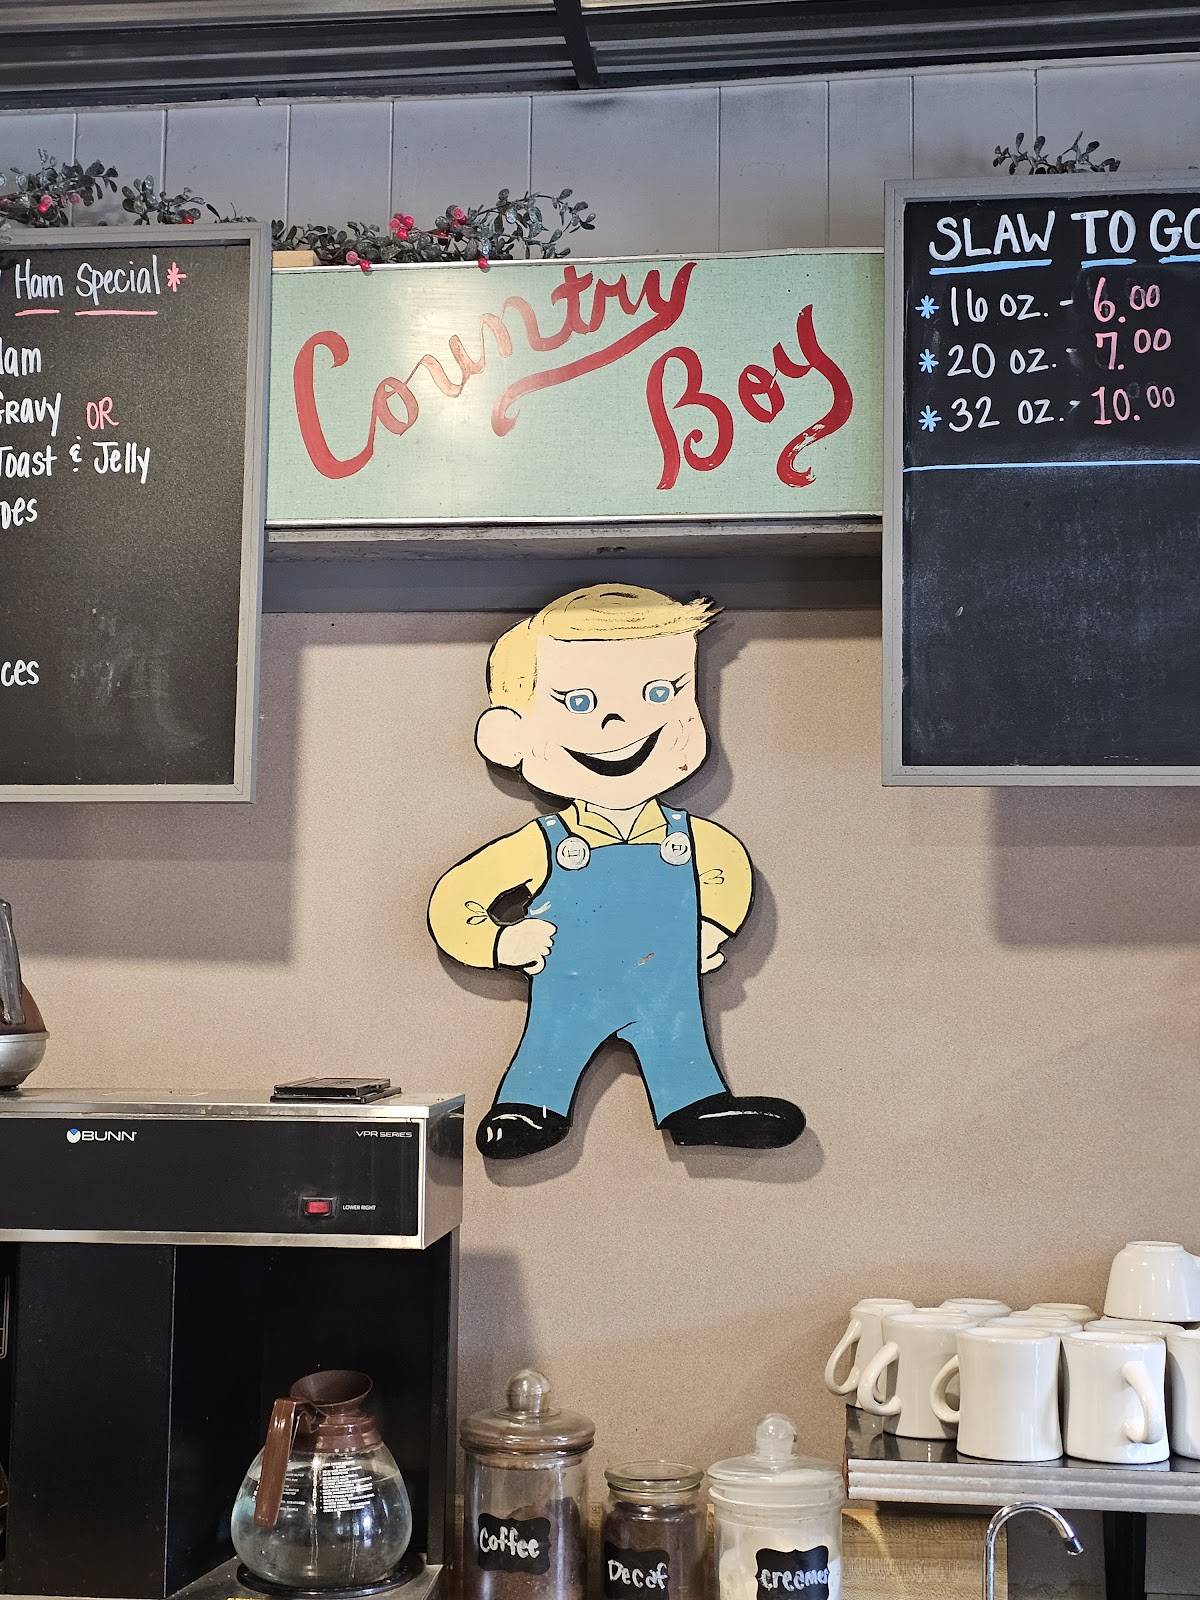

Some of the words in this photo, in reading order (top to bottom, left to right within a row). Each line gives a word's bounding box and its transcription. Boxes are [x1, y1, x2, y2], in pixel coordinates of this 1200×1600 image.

[929, 210, 1055, 261] SLAW
[1071, 209, 1136, 254] TO
[15, 258, 64, 300] Ham
[75, 254, 161, 306] Special
[951, 286, 989, 327] 16
[0, 336, 42, 377] am
[293, 262, 697, 480] Country
[947, 342, 996, 379] 20
[86, 396, 120, 430] OR
[646, 304, 854, 490] Boy
[949, 395, 1000, 433] 32
[69, 435, 83, 473] &
[93, 441, 151, 485] Jelly
[81, 1130, 136, 1142] BUNN
[355, 1130, 379, 1138] VPR
[479, 1526, 541, 1559] Coffee
[607, 1559, 668, 1590] Decaf
